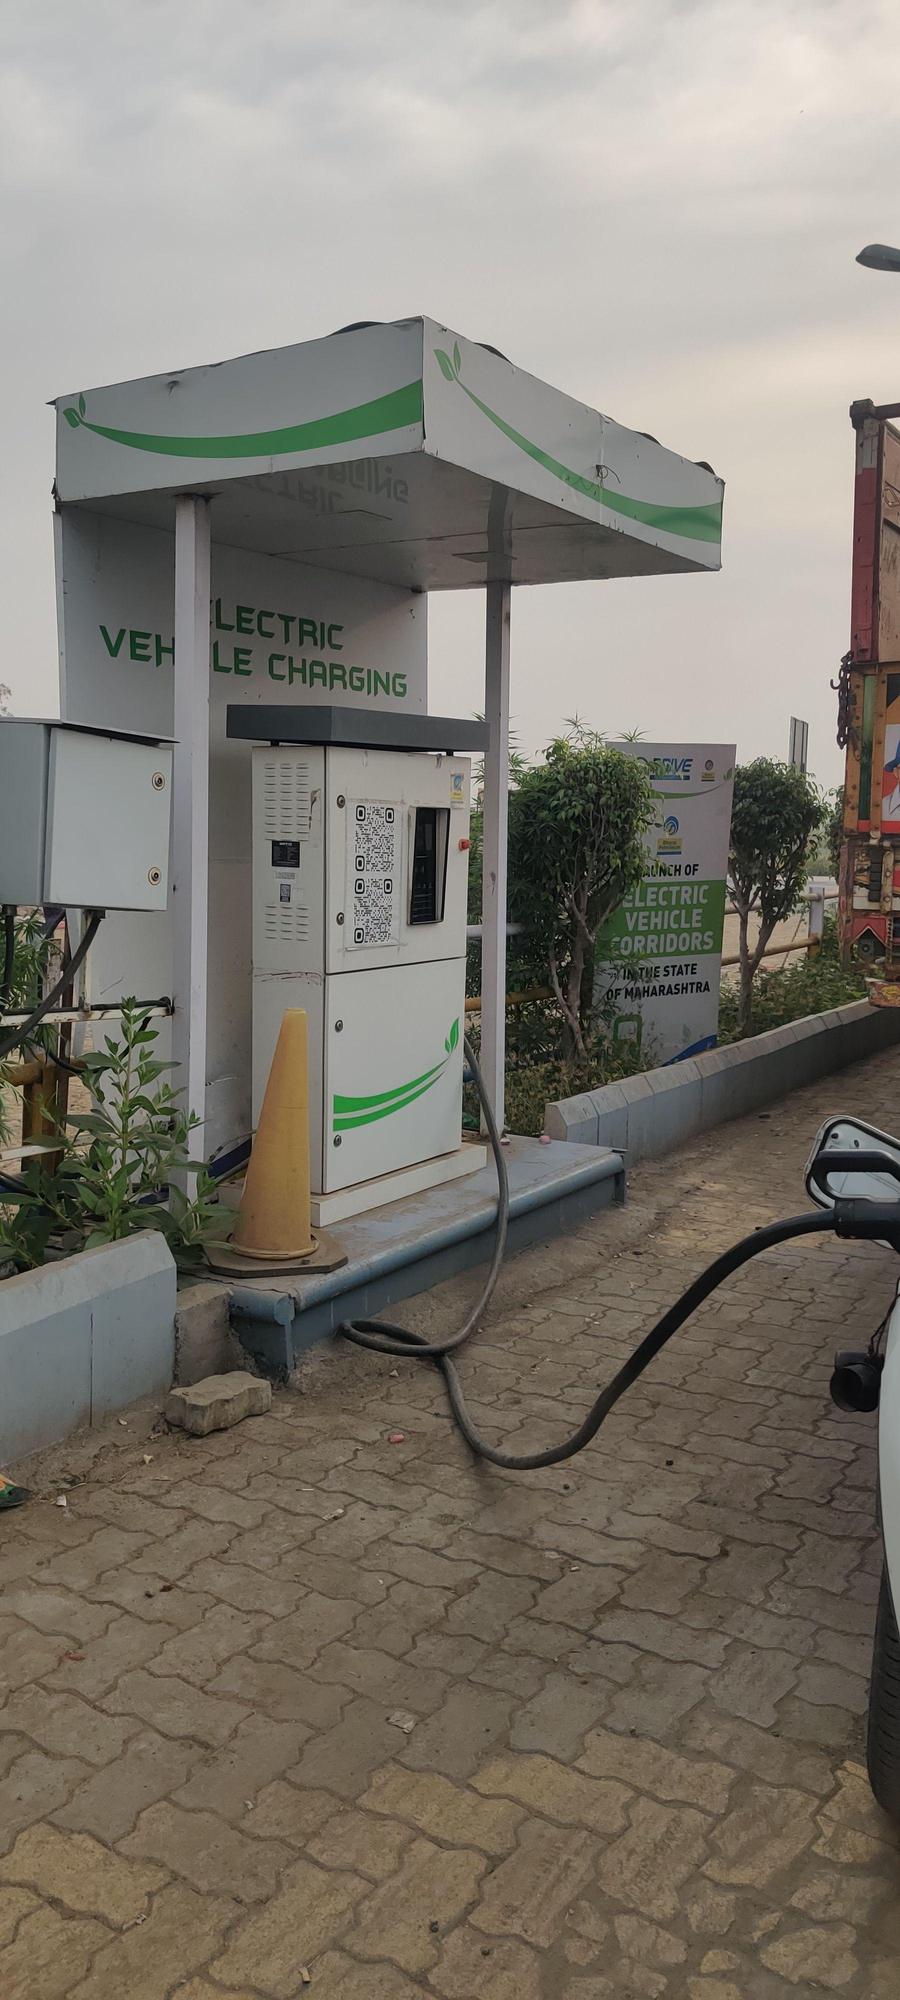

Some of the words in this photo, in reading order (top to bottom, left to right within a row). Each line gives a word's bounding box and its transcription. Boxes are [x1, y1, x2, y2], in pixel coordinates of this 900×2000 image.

[208, 598, 345, 652] LECTRIC
[99, 624, 254, 677] VEHLE
[267, 652, 408, 698] CHARGING
[640, 863, 682, 877] AUNCH
[684, 863, 699, 876] OF
[625, 908, 703, 931] VEHICLE
[622, 968, 635, 981] IN
[639, 966, 661, 979] THE
[662, 963, 698, 977] STATE
[606, 988, 622, 1001] OF
[624, 981, 711, 1001] MAHARASHTRA
